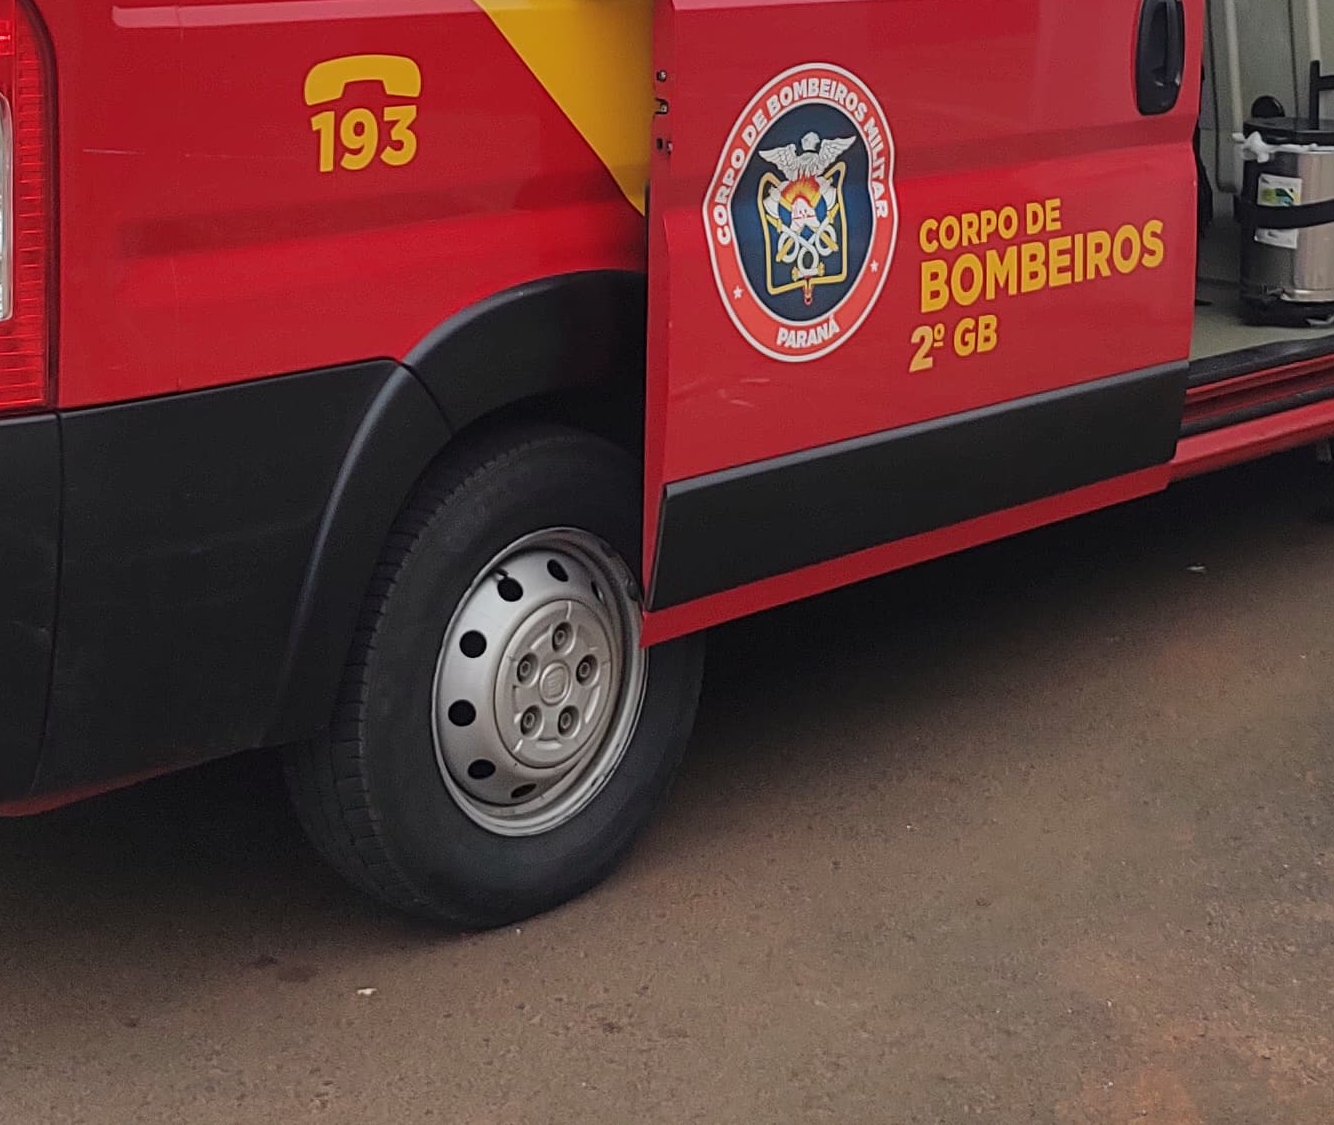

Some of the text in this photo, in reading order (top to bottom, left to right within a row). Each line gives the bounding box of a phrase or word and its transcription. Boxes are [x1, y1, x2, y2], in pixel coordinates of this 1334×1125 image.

[310, 104, 418, 173] 193
[712, 76, 889, 246] CORPO DE BOMBEIROS MILITAR
[918, 197, 1062, 254] CORPO DE
[919, 218, 1165, 314] BOMBEIROS
[775, 318, 841, 348] PARANÁ
[952, 313, 999, 358] GB
